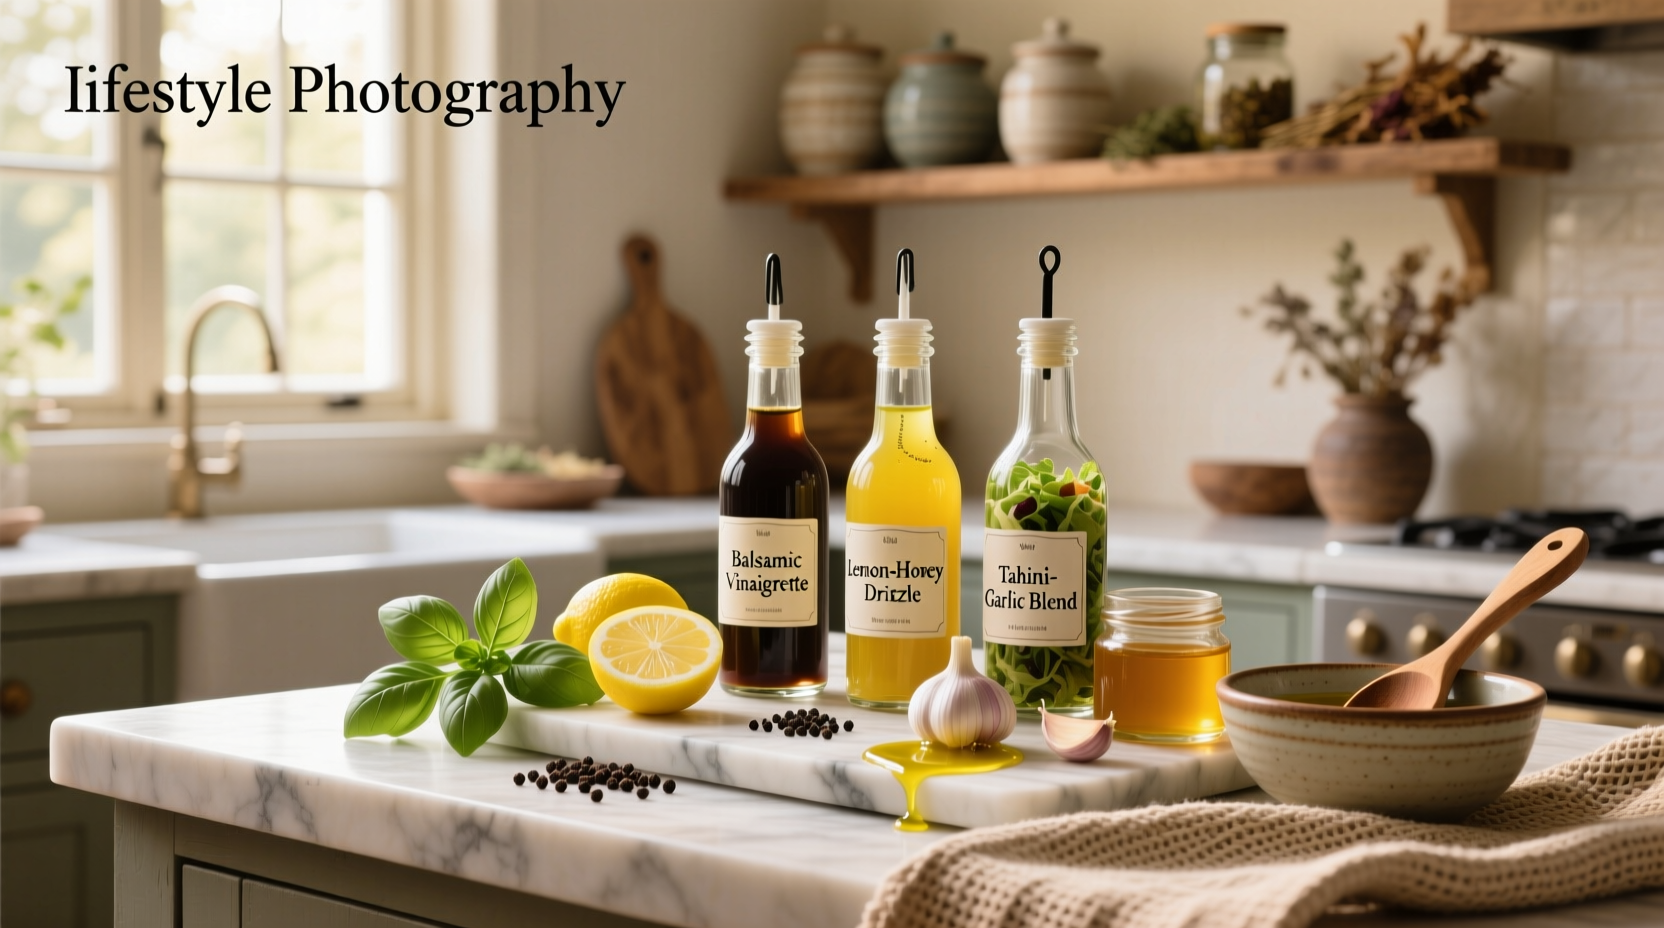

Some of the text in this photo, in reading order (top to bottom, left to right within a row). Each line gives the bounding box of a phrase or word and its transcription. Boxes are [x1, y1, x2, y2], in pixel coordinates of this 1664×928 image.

[731, 549, 803, 569] Balsamic
[725, 572, 809, 598] Vinaigrette
[998, 565, 1058, 585] Tahini-
[984, 588, 1078, 611] Garlic Blend
